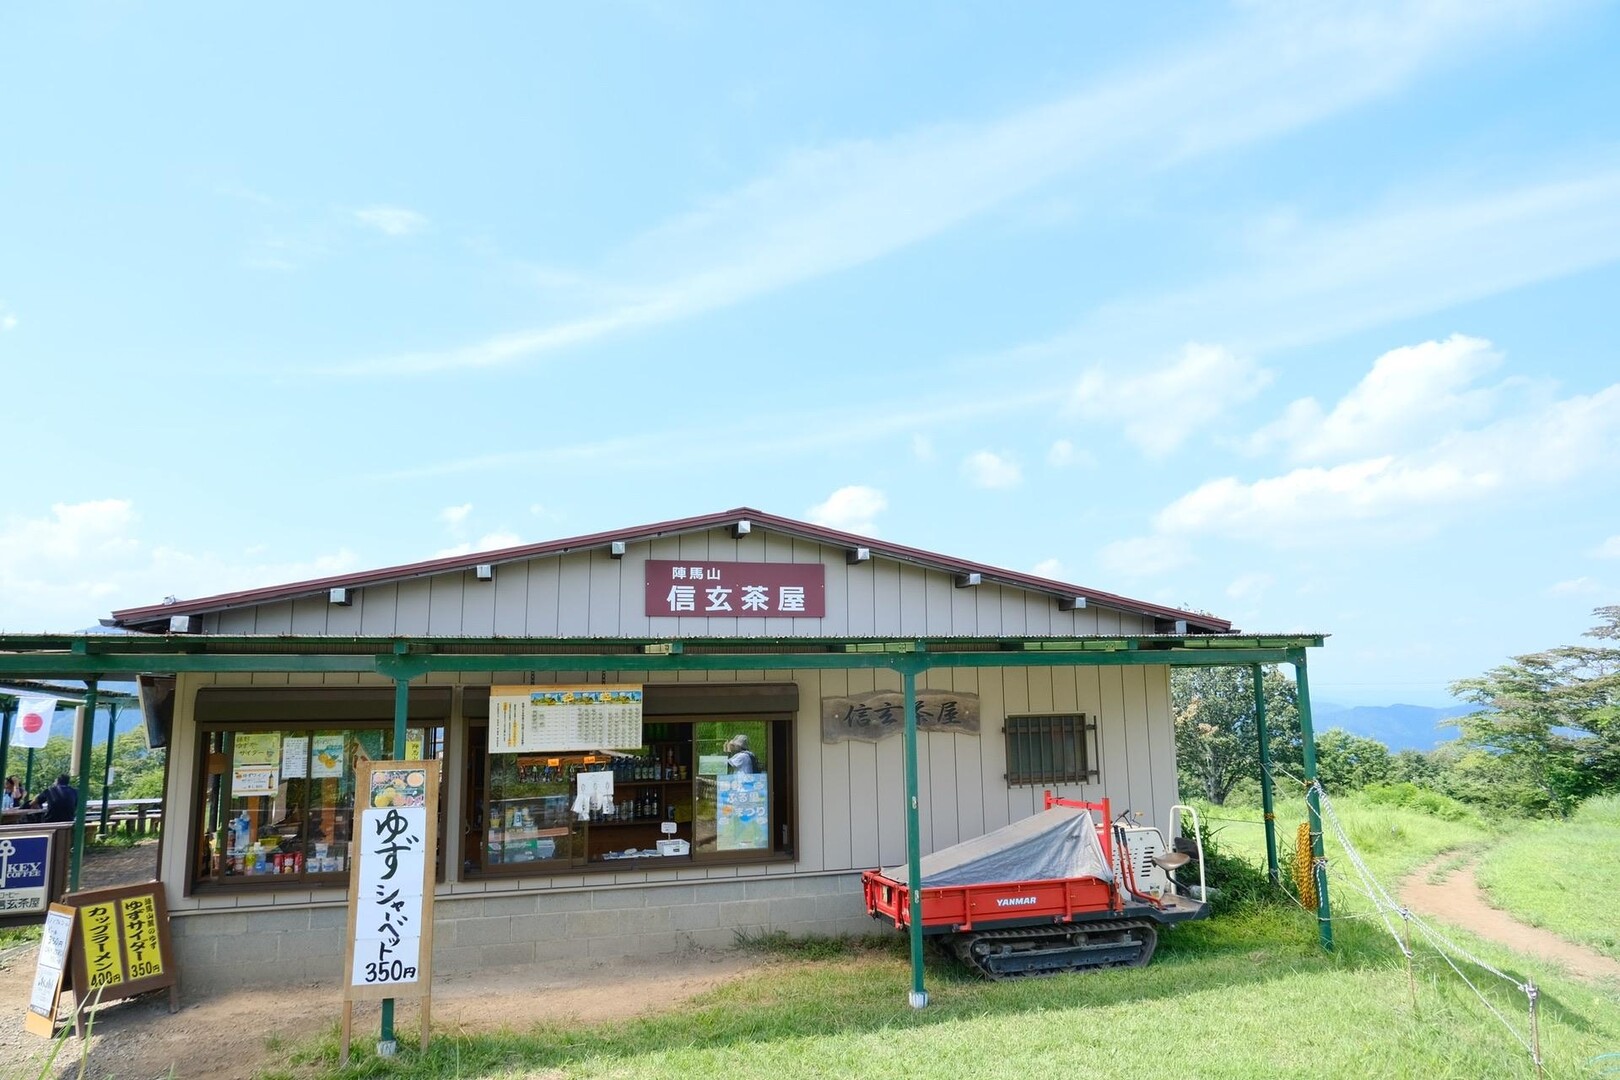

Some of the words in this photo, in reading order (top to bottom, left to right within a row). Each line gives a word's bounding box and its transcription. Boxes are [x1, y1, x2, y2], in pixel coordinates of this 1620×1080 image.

[672, 567, 721, 580] 陣馬山
[667, 585, 805, 612] 信玄茶屋
[7, 871, 41, 879] COFFEE
[8, 862, 41, 872] KEY
[374, 809, 420, 962] ゆずシャーベット
[996, 896, 1037, 907] YANMAR
[88, 907, 114, 972] カップラーメン
[125, 900, 149, 962] ゆずサイダー
[131, 961, 160, 978] 350円
[365, 960, 417, 983] 350円
[90, 971, 121, 988] 400円
